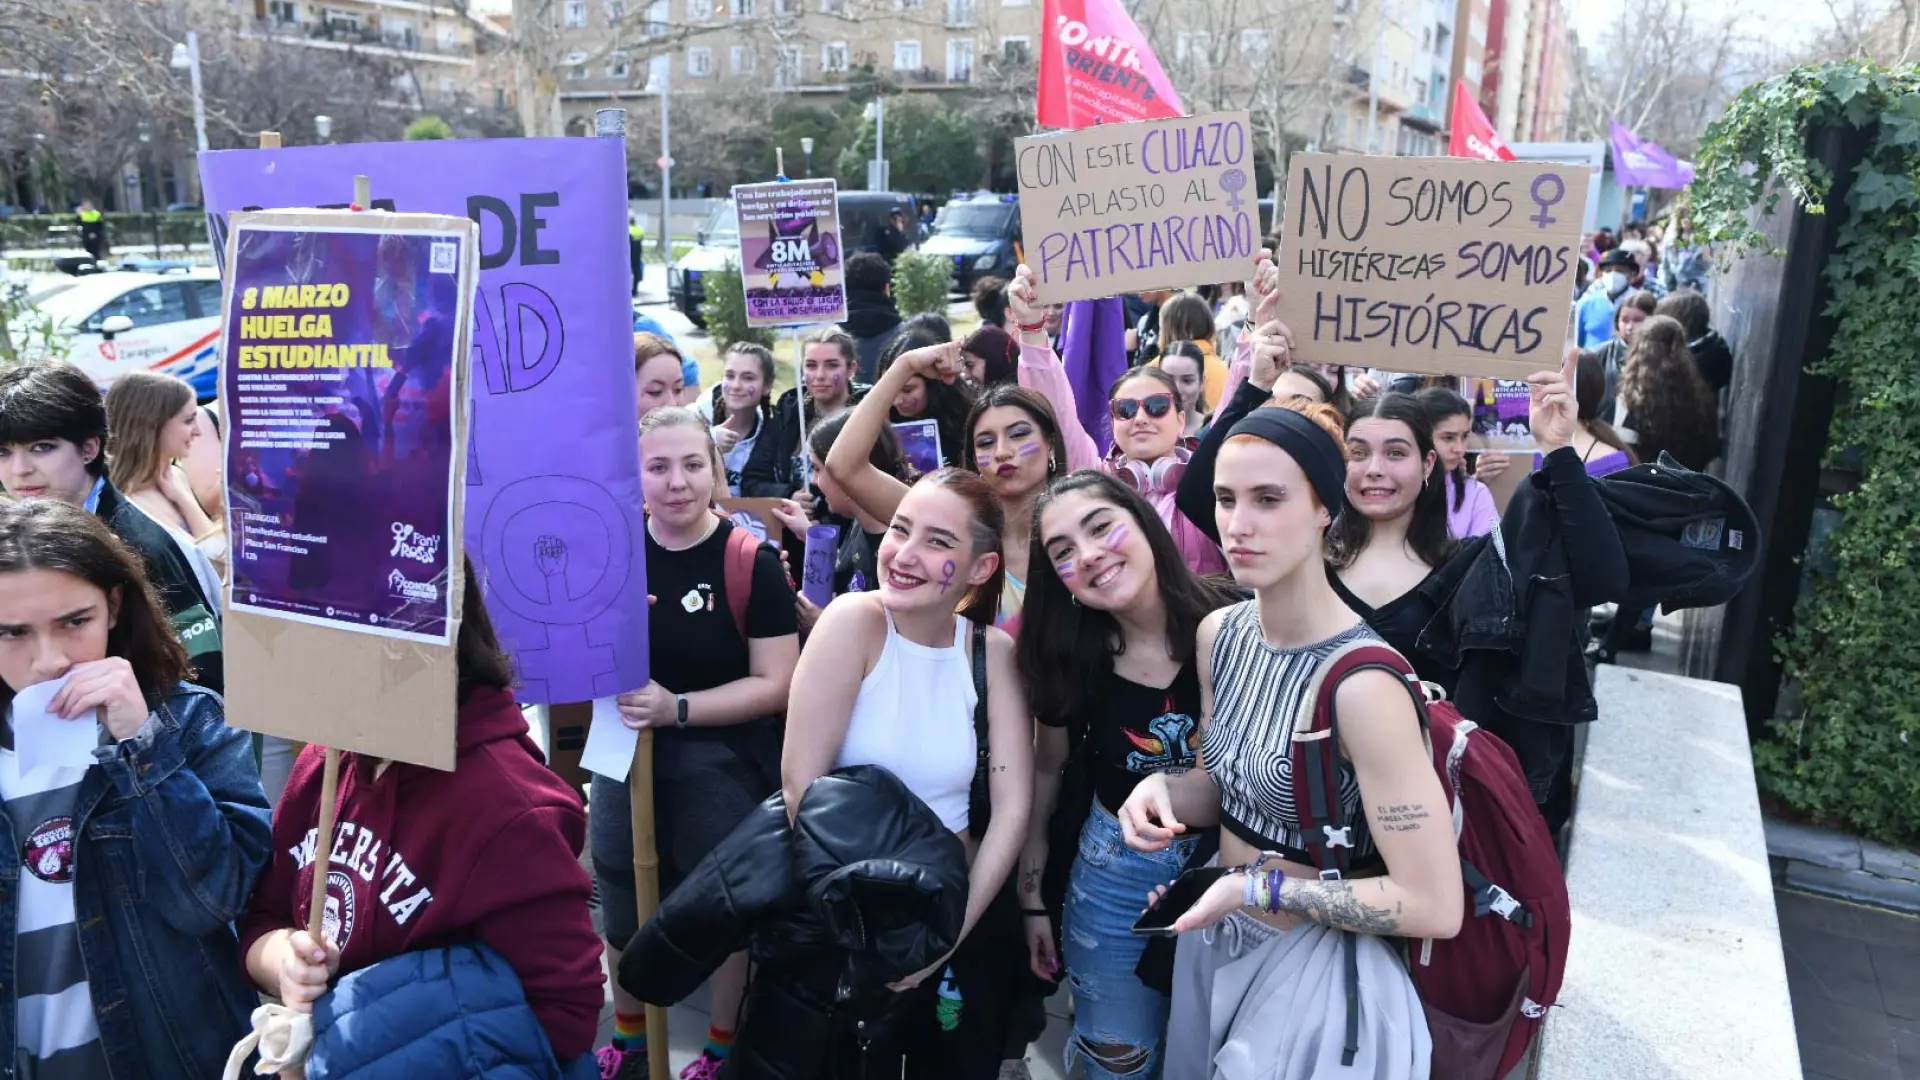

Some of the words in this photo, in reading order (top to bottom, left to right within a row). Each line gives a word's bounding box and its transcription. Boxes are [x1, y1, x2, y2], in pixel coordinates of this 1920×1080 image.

[1018, 142, 1077, 189] CON
[1087, 142, 1135, 169] ESTE
[1141, 121, 1244, 174] CULAZO
[1057, 184, 1165, 219] APLASTO
[1184, 179, 1216, 203] AL
[1299, 165, 1370, 241] NO
[1385, 177, 1513, 227] SOMOS
[466, 192, 560, 270] DE
[771, 239, 811, 263] 8M
[1039, 211, 1252, 283] PATRIARCADO
[1299, 246, 1446, 283] HISTÉRICAS
[1456, 241, 1570, 286] SOMOS
[242, 287, 258, 310] 8
[261, 283, 350, 309] MARZO
[240, 315, 333, 339] HUELGA
[1313, 292, 1548, 354] HISTÓRICAS
[238, 344, 393, 369] ESTUDIANTIL
[245, 538, 263, 548] Plaza
[263, 541, 277, 550] San
[277, 543, 309, 555] Francisco
